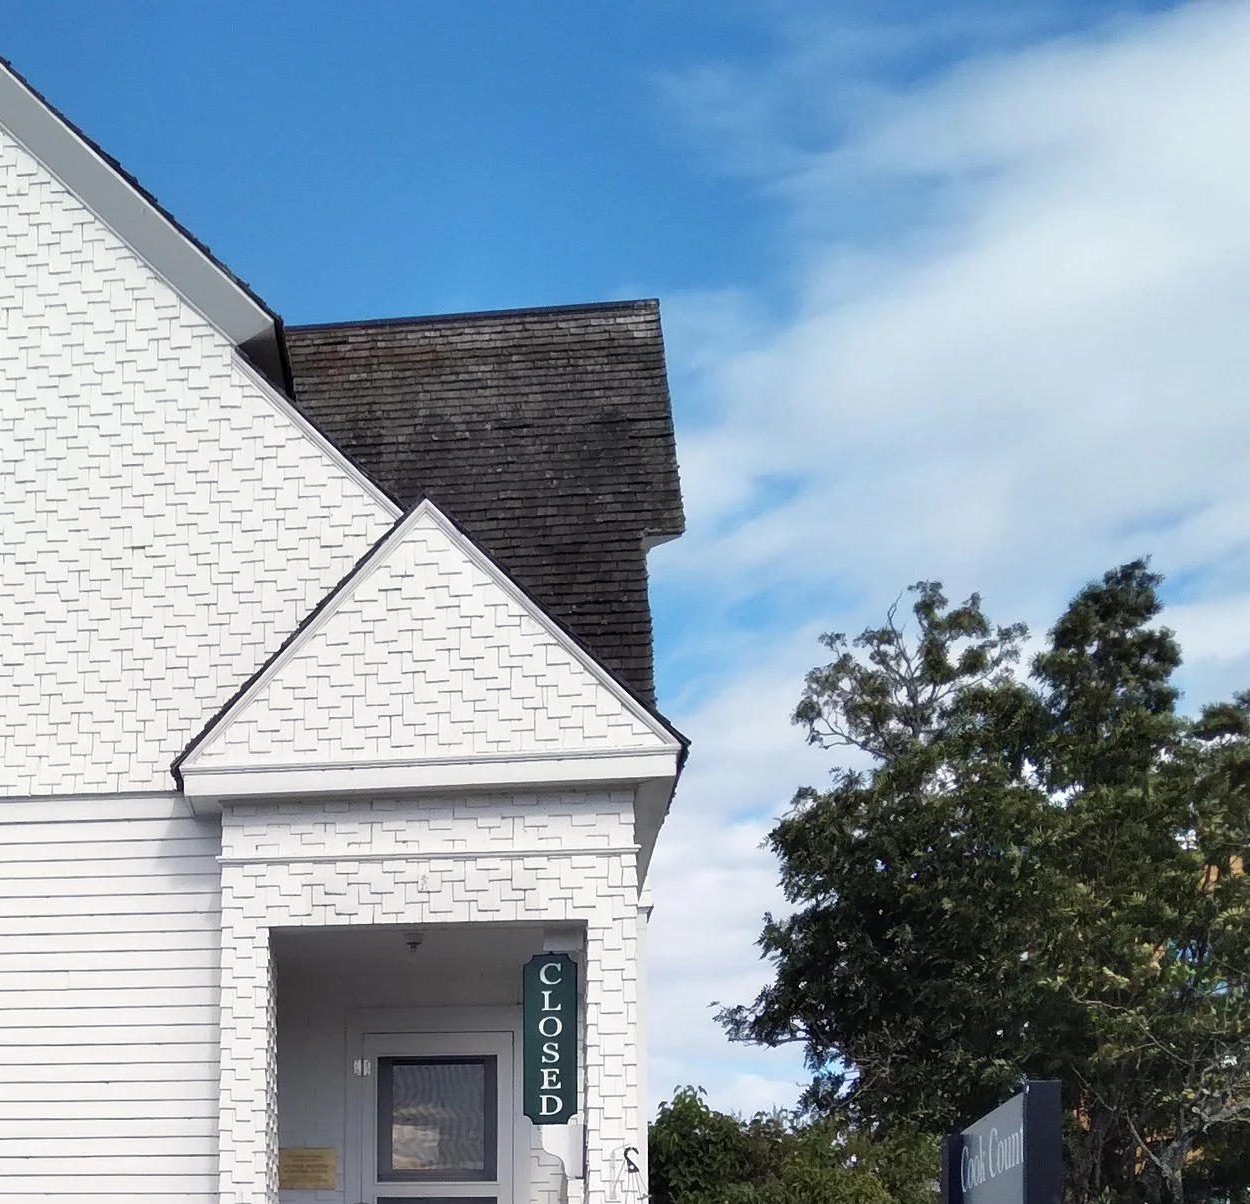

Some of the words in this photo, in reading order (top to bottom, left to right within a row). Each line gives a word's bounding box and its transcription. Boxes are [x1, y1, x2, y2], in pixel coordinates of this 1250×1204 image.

[538, 962, 563, 1116] CLOSED
[961, 1135, 986, 1193] Cook
[989, 1127, 1024, 1178] Count
